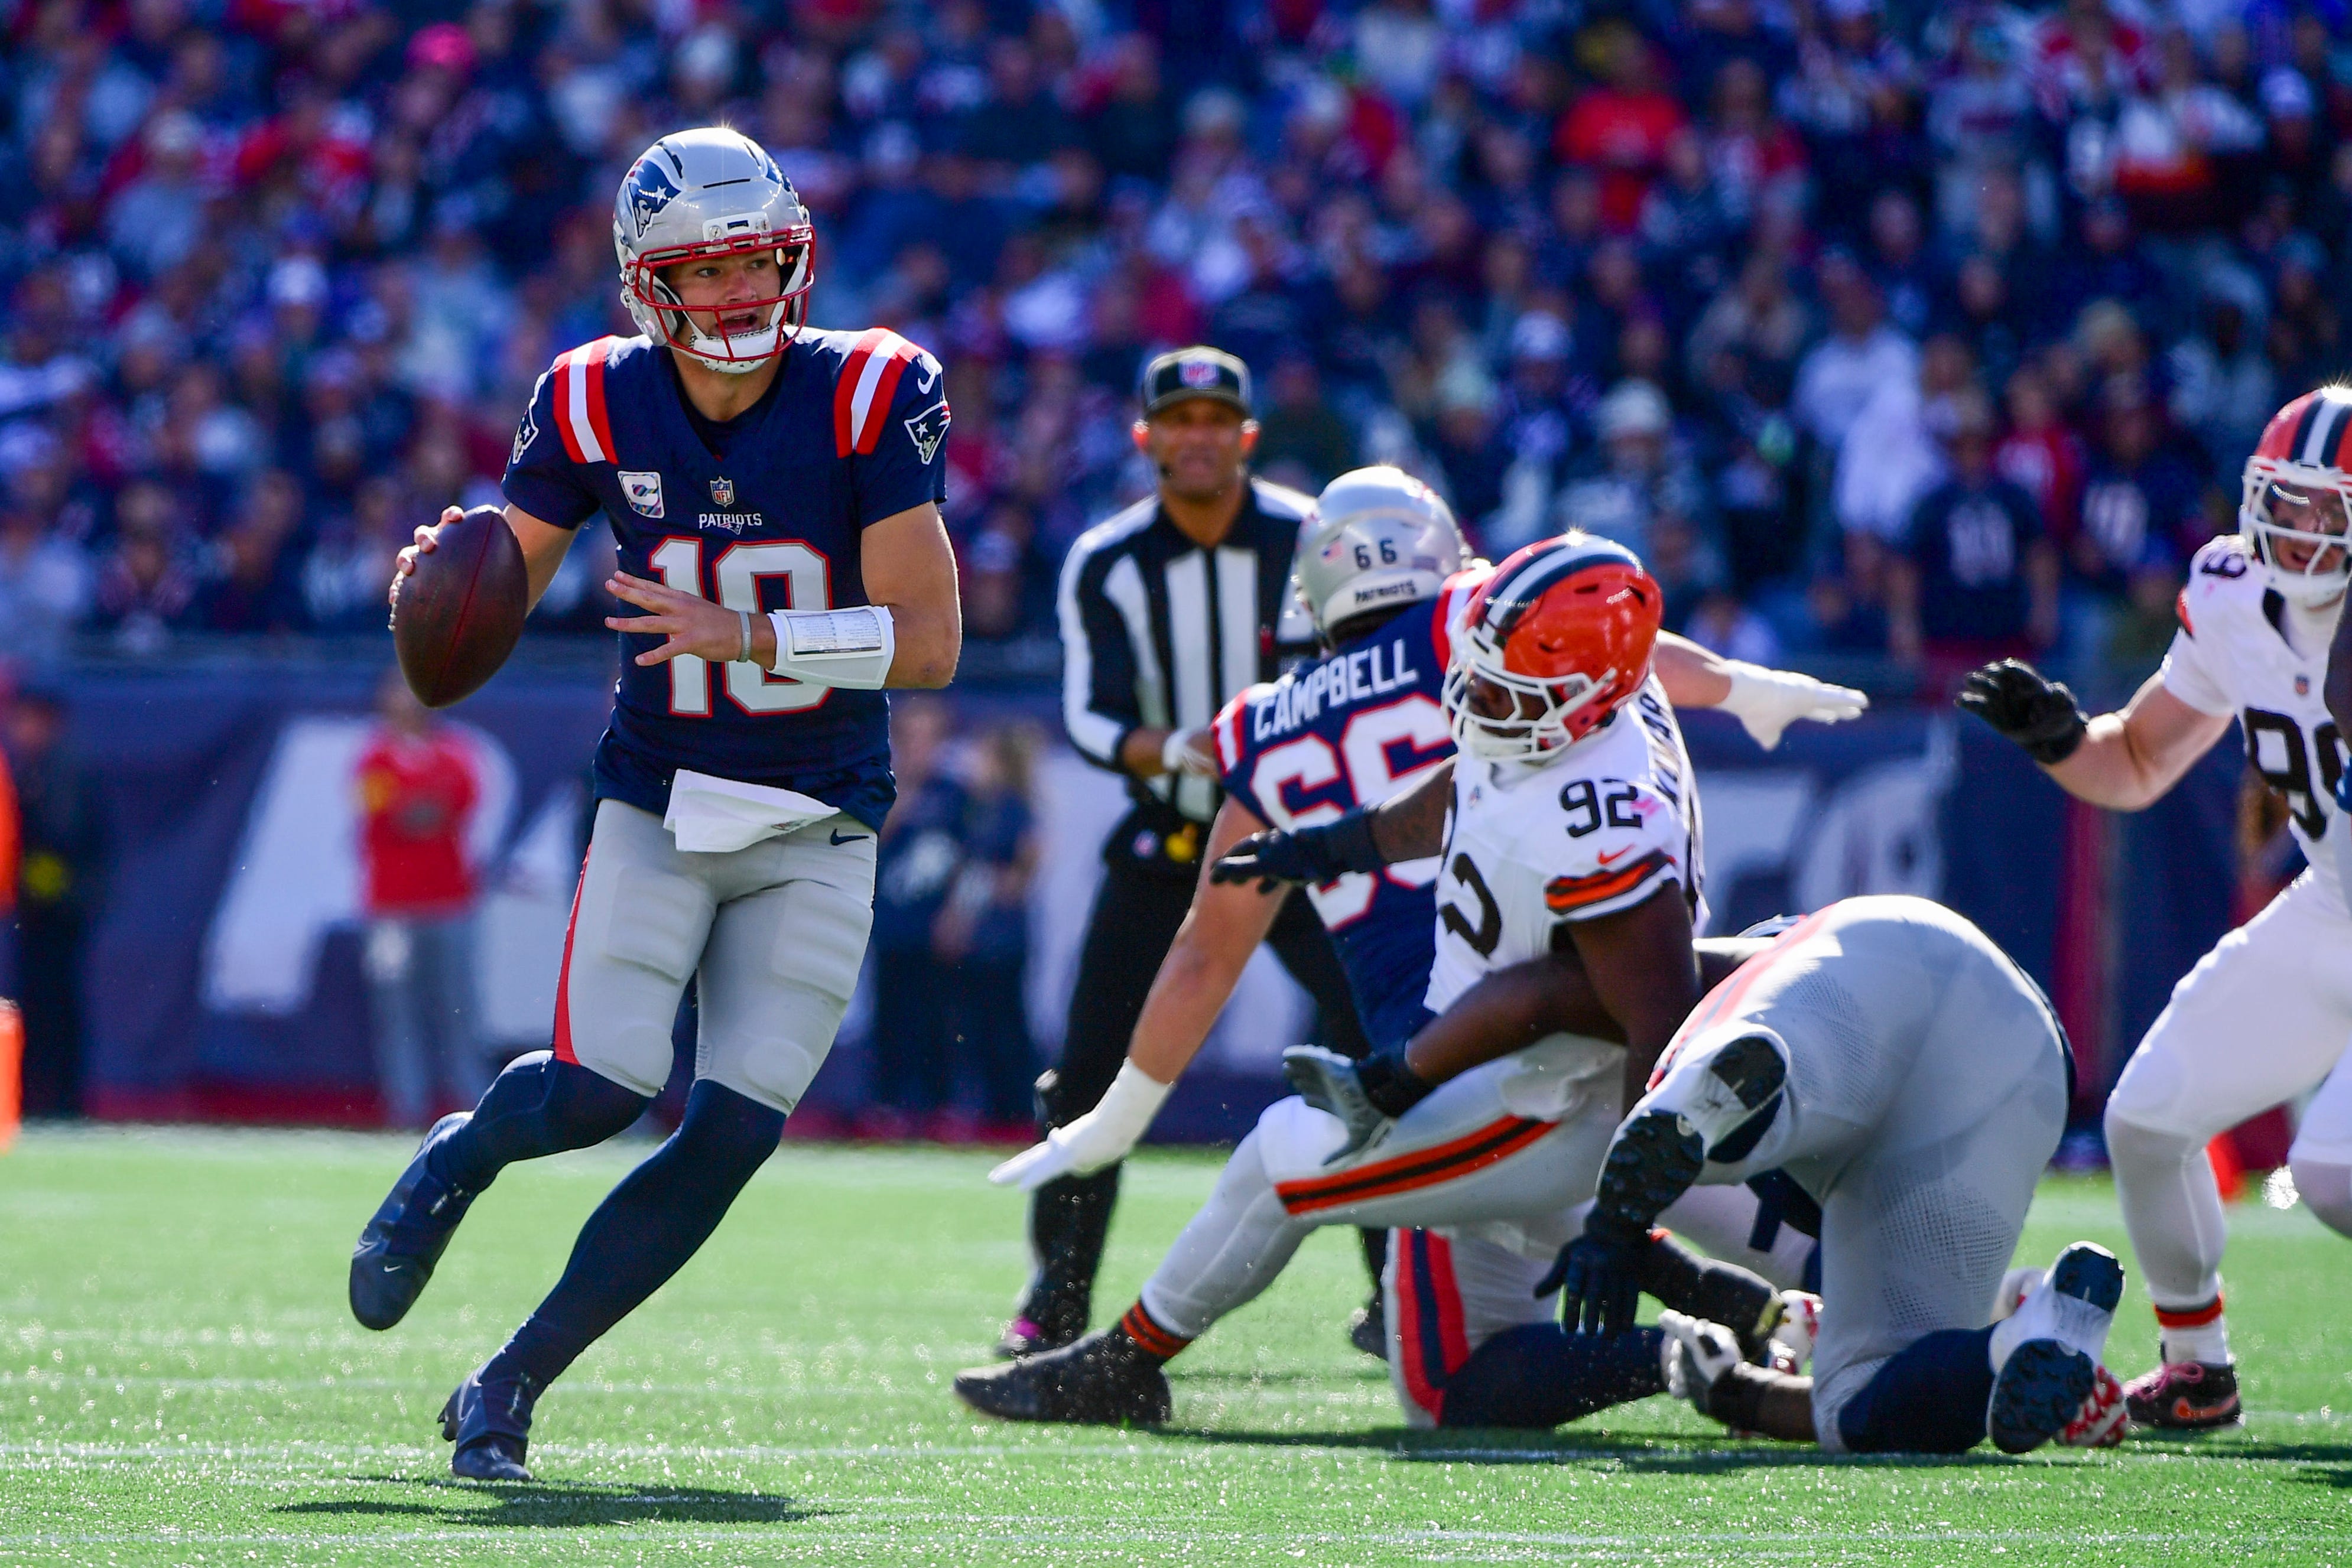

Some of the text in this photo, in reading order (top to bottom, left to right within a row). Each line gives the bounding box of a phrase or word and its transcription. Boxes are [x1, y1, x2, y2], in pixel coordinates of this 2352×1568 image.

[714, 490, 732, 502] NFL
[699, 512, 763, 529] PATRIOTS
[1354, 538, 1397, 571] 66
[649, 535, 833, 718] 10
[1253, 638, 1419, 743] CAMPBELL
[1558, 778, 1643, 838] 92
